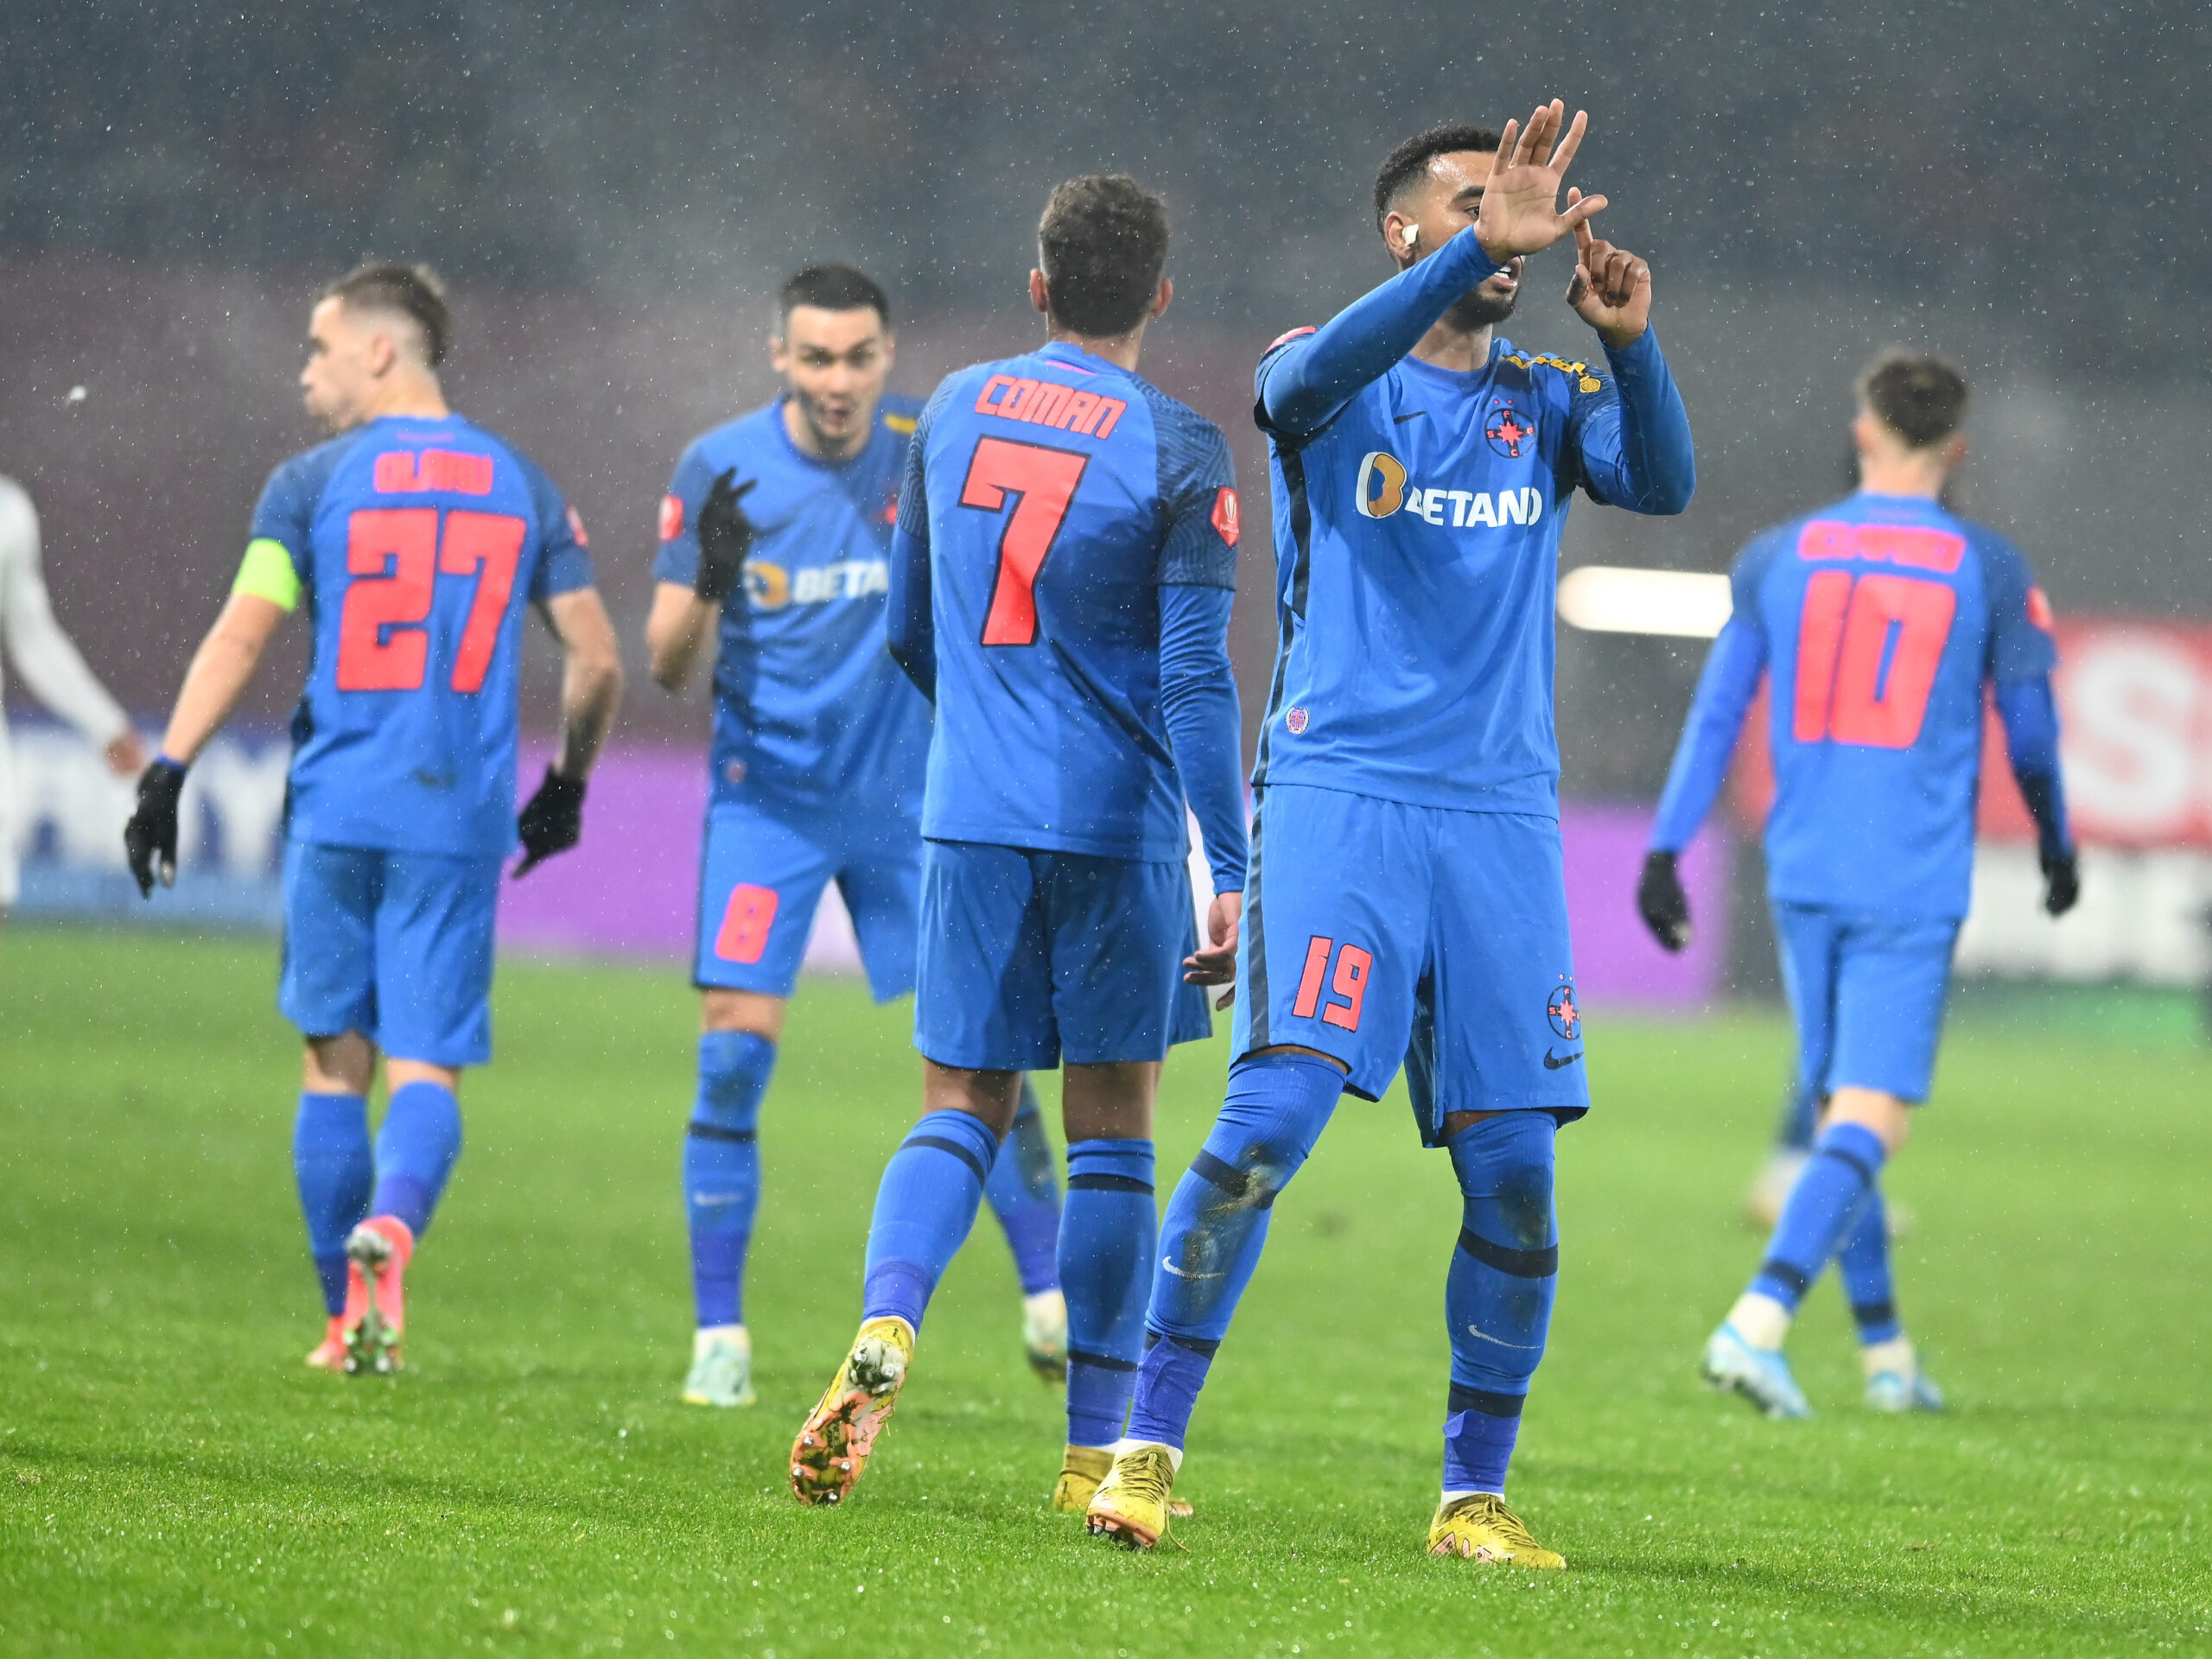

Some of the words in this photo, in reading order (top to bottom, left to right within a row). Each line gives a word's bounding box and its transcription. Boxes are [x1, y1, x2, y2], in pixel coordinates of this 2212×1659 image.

[975, 374, 1128, 440] COMAN
[336, 506, 528, 692] 27
[958, 435, 1089, 647] 7
[1793, 569, 1957, 749] 10
[715, 883, 779, 964] 8
[1292, 935, 1373, 1033] 19
